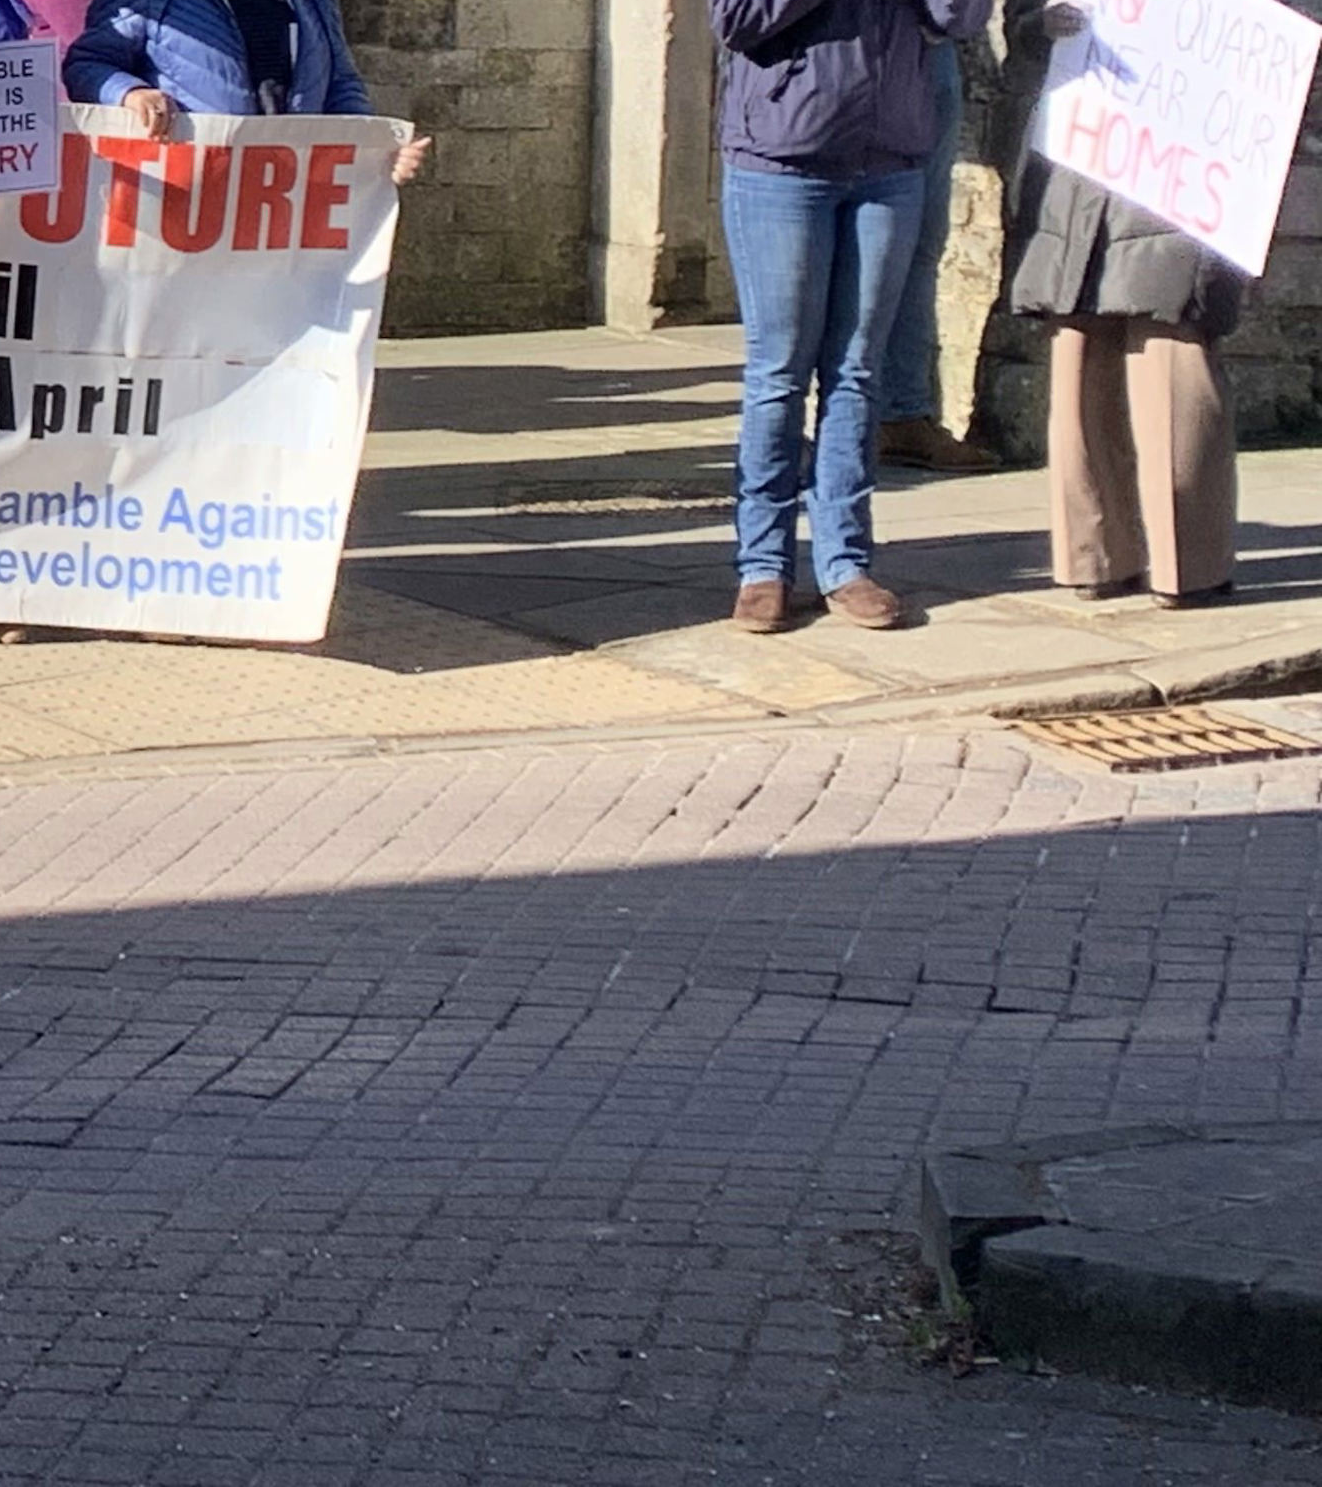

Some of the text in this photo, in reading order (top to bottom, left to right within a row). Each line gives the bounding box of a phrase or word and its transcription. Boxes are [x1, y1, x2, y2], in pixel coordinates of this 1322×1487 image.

[5, 87, 24, 106] IS
[1084, 38, 1275, 177] NEAR OUR
[1063, 95, 1231, 234] HOMES
[158, 488, 340, 549] Against
